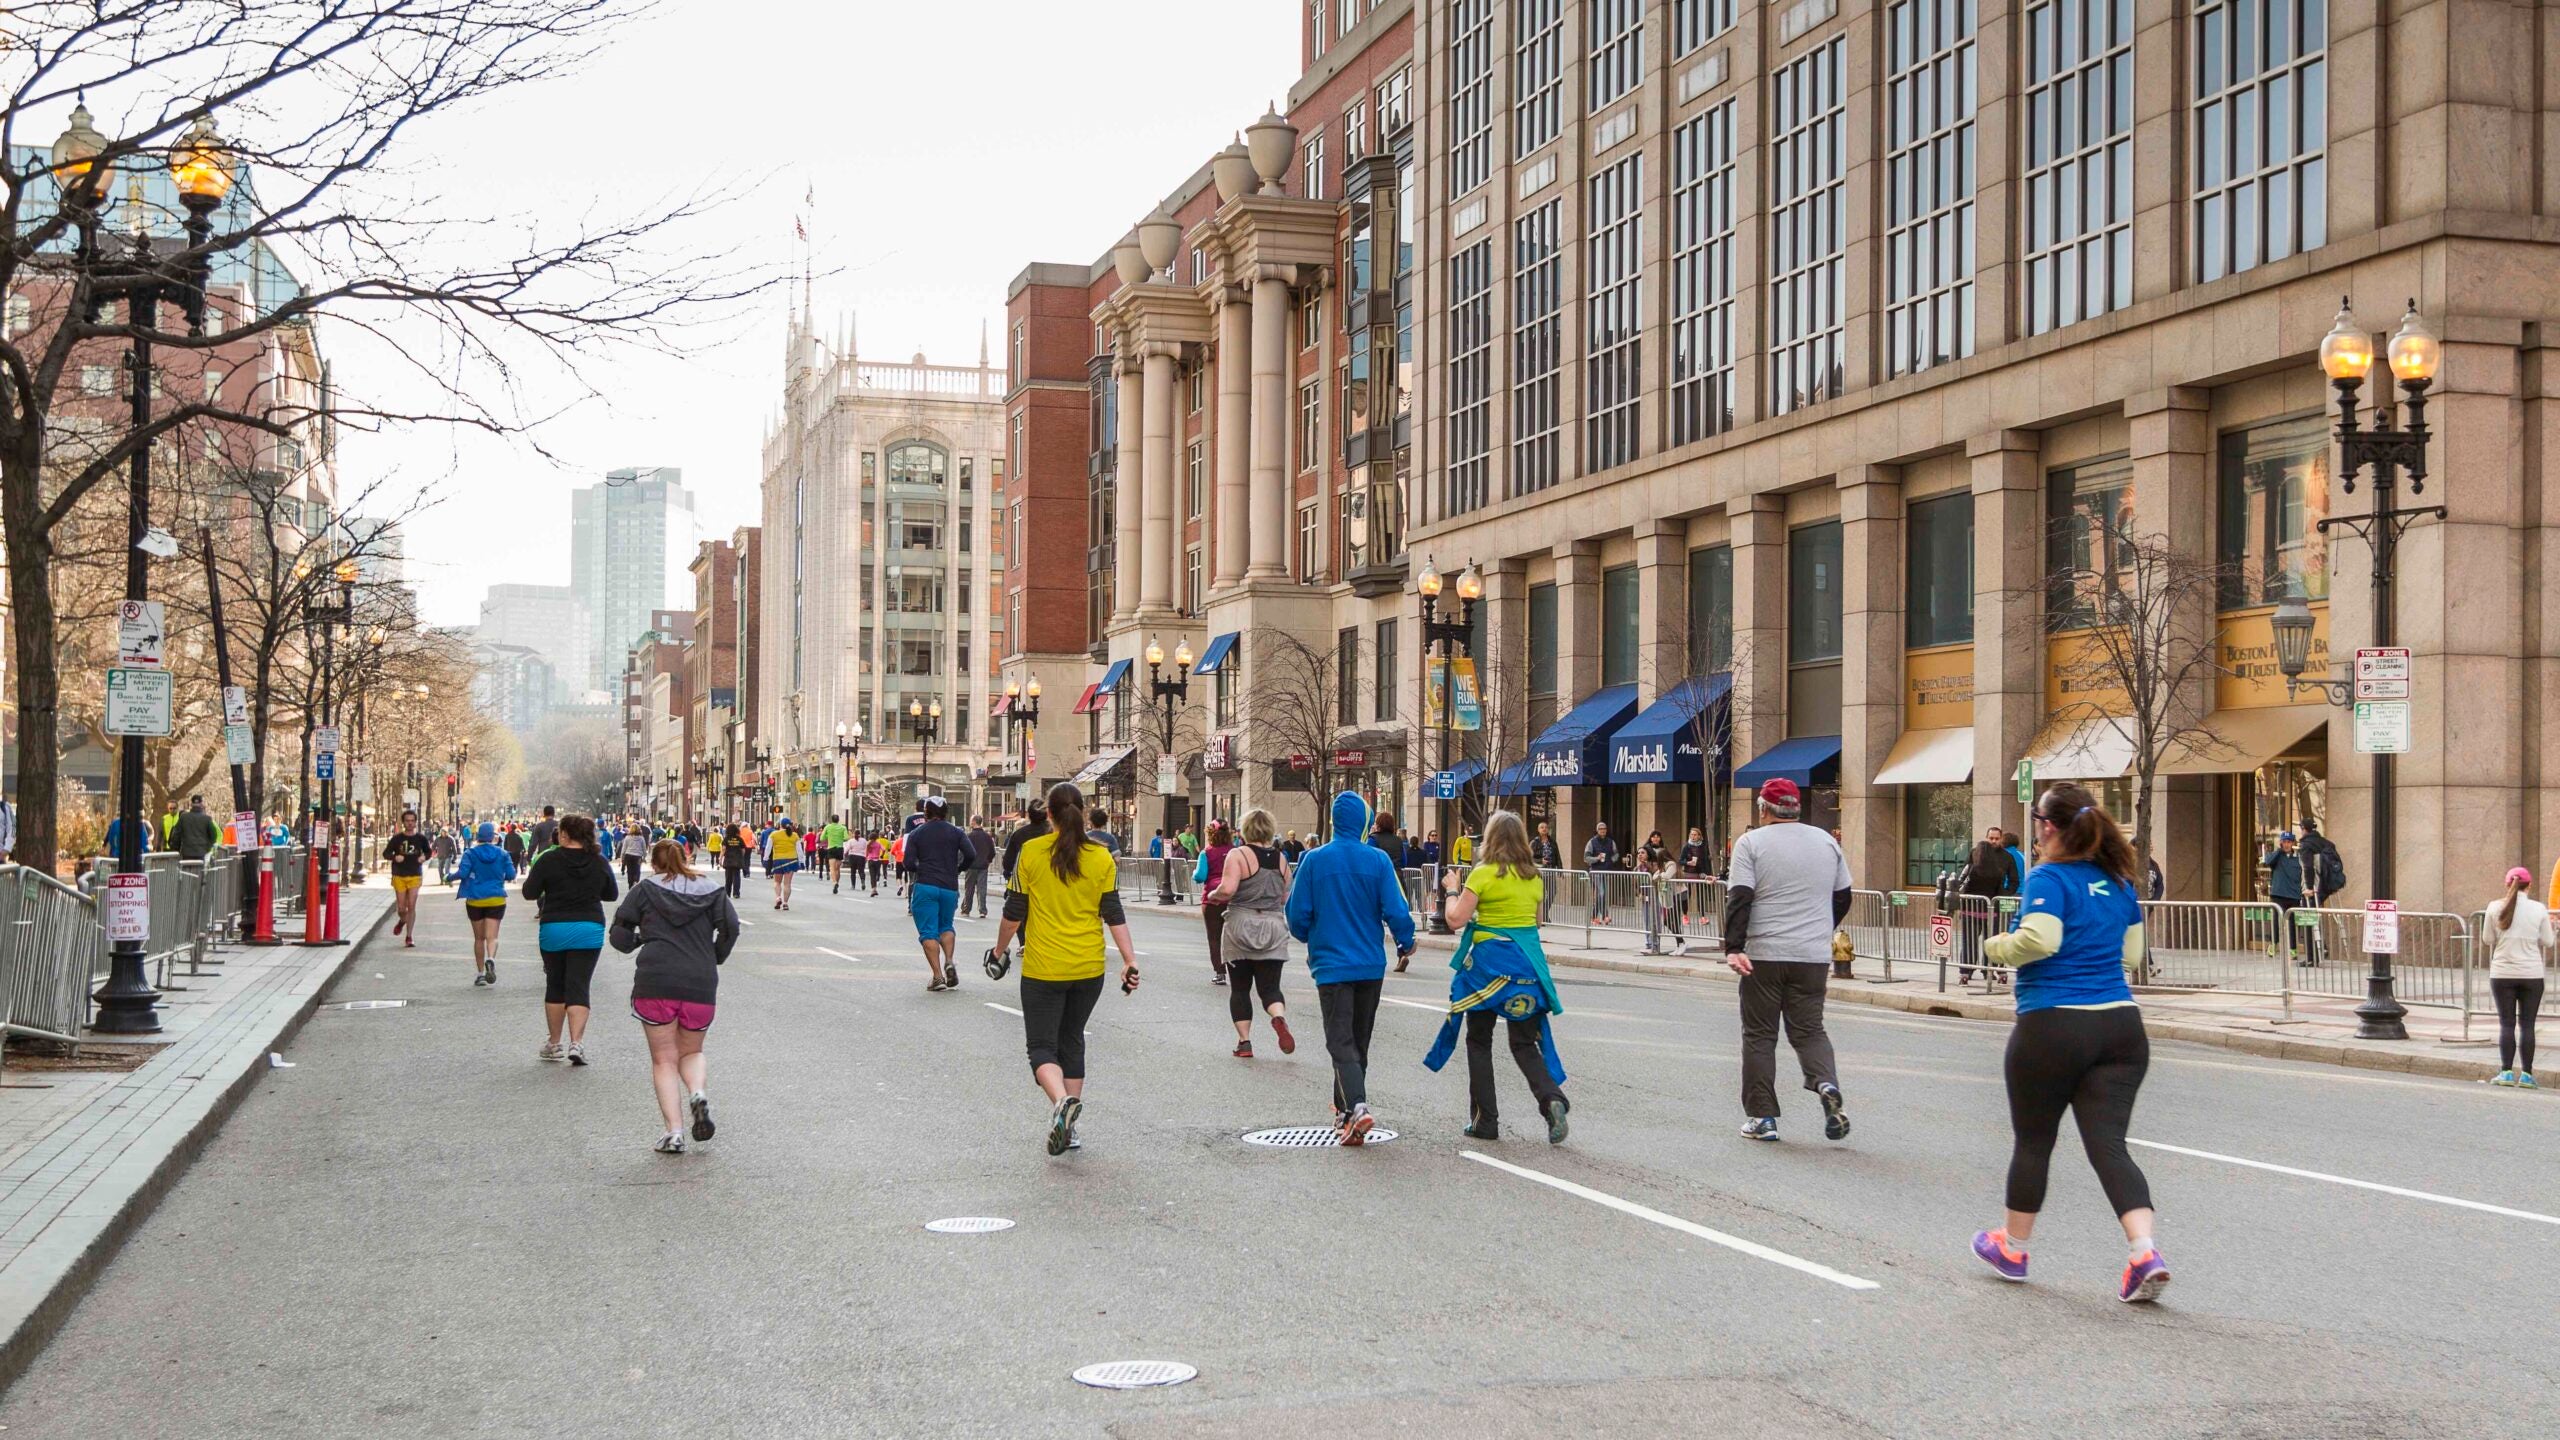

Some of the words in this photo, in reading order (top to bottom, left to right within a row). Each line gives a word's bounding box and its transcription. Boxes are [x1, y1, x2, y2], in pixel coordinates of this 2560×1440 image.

[2226, 646, 2268, 661] BOSTON
[2246, 663, 2278, 677] TRUST
[112, 671, 124, 684] 2
[1456, 674, 1475, 691] WE
[1457, 691, 1477, 705] RUN
[2358, 704, 2370, 715] 2
[1211, 735, 1225, 752] CITY
[1204, 751, 1225, 769] SPORTS
[1532, 749, 1579, 778] Marshalls
[1613, 744, 1668, 774] Marshalls
[110, 878, 123, 886] TOW
[124, 877, 146, 886] ZONE
[118, 890, 134, 899] NO
